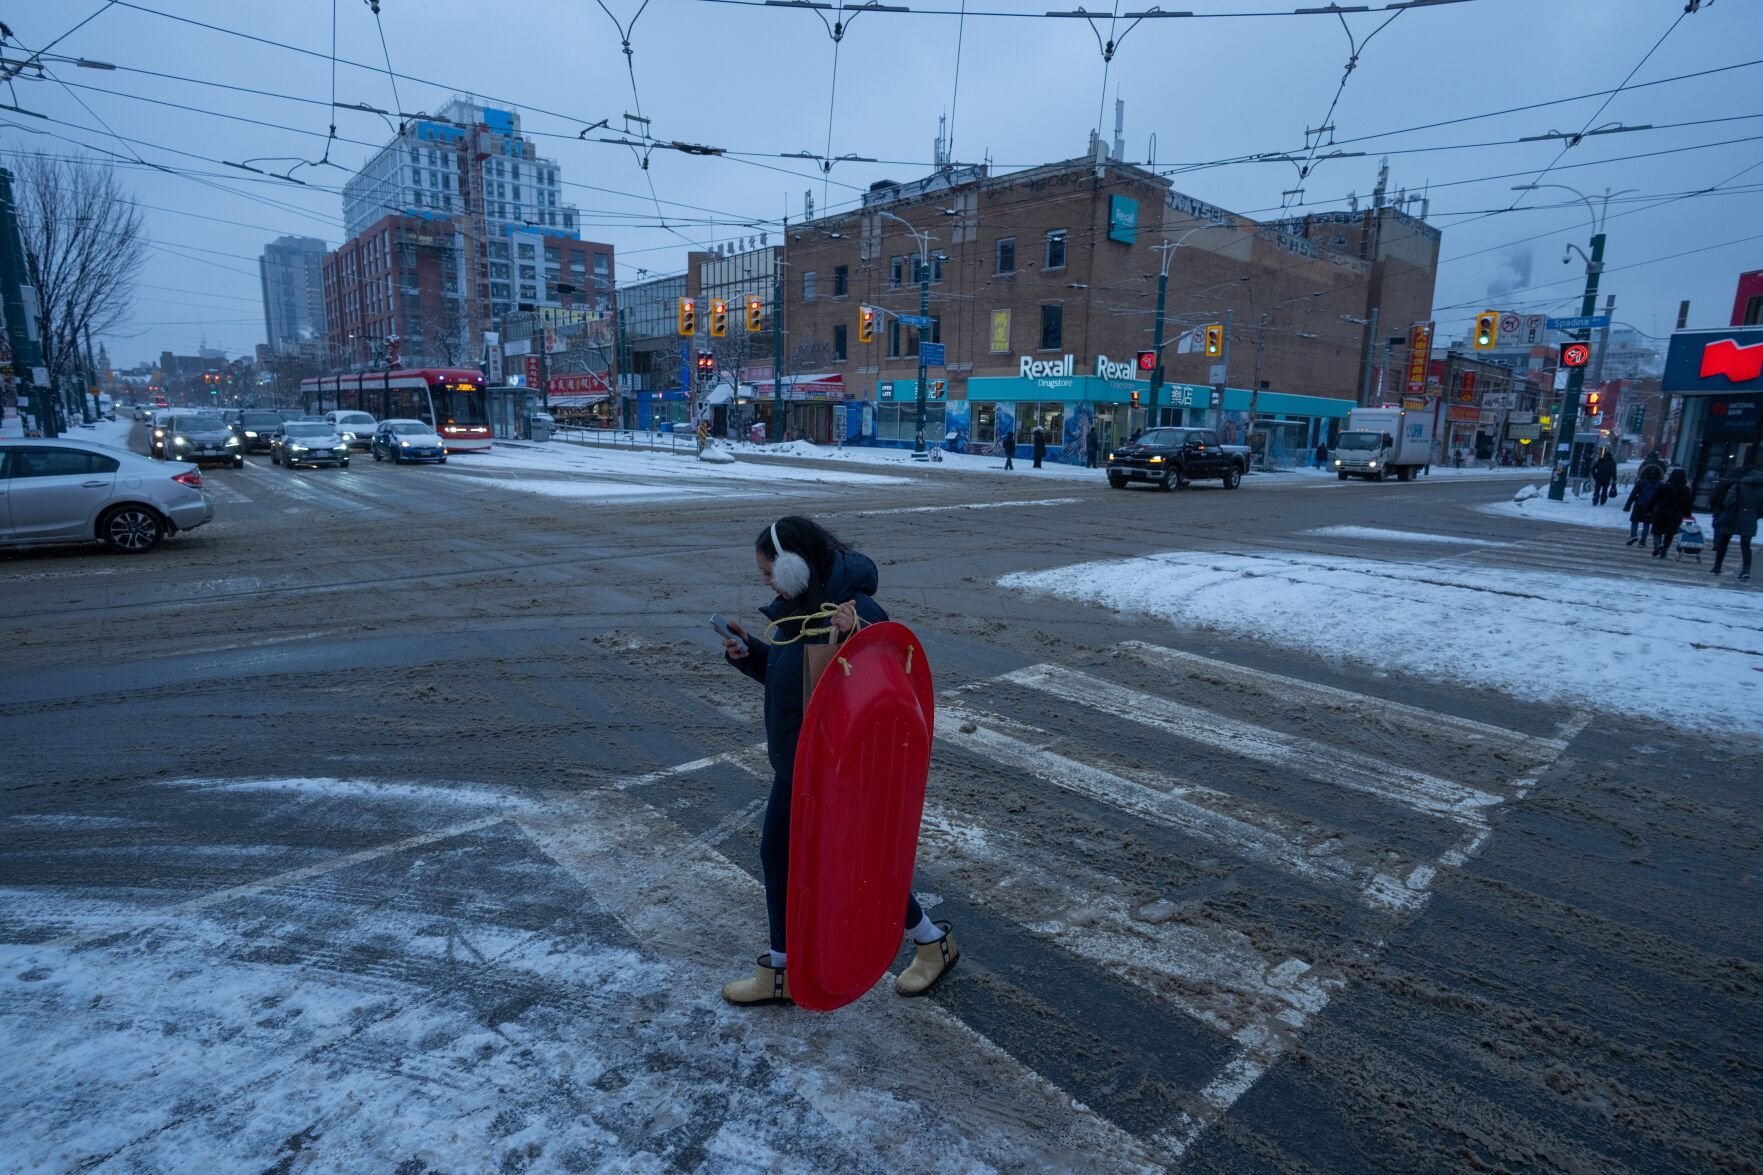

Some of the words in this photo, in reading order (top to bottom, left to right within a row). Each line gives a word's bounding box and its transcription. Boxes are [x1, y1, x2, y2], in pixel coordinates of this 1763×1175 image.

[1116, 208, 1135, 223] Rexall
[1554, 319, 1589, 328] Spadina
[1020, 354, 1073, 380] Rexall
[1097, 354, 1137, 381] Rexall
[1038, 380, 1073, 389] Drugstore
